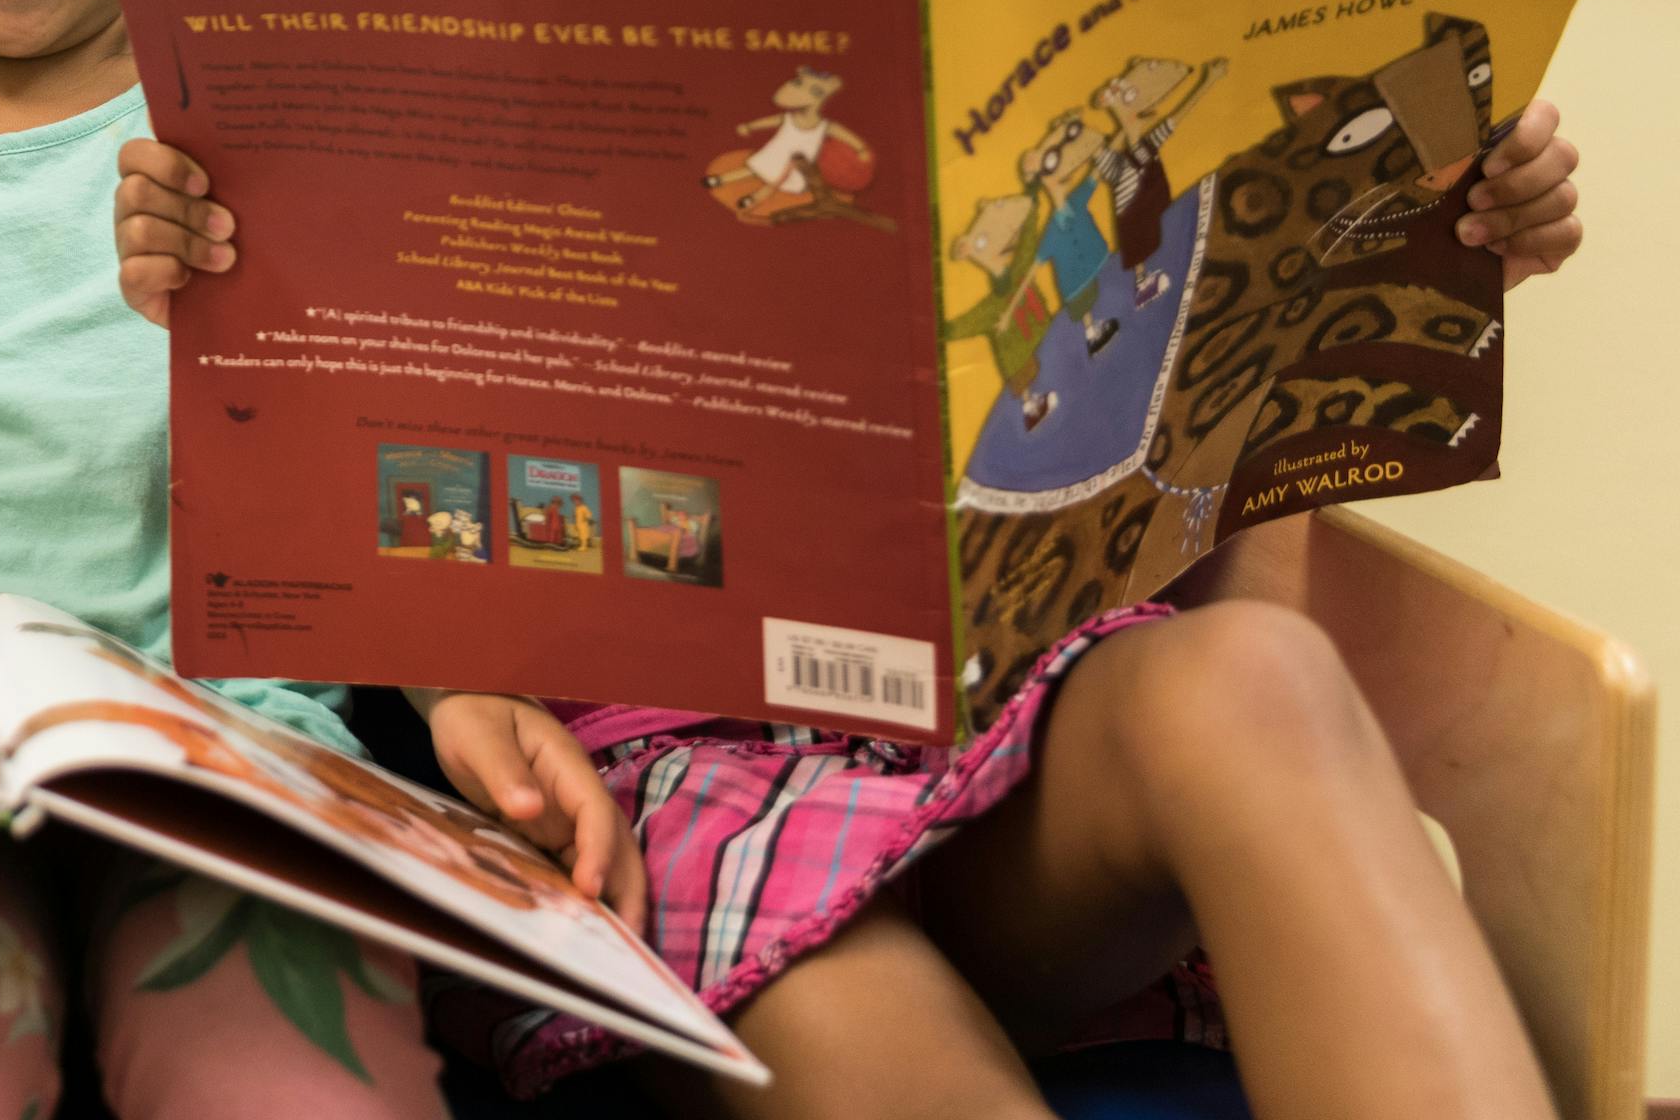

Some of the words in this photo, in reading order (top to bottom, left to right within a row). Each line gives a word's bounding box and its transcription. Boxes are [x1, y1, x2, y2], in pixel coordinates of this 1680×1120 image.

[184, 13, 252, 32] WILL
[260, 12, 348, 31] THEIR
[356, 12, 524, 42] FRIENDSHIP
[534, 22, 612, 46] EVER
[622, 25, 659, 47] BE
[670, 26, 732, 50] THE
[745, 28, 849, 54] SAME?
[1243, 6, 1326, 40] JAMES
[953, 23, 1072, 157] Horace
[344, 310, 387, 325] spirited
[390, 313, 430, 328] tribute
[432, 320, 446, 330] to
[447, 317, 508, 340] friendship
[510, 326, 533, 339] and
[308, 335, 339, 344] room
[341, 337, 357, 346] on
[359, 338, 386, 351] your
[389, 336, 429, 352] shelves
[431, 339, 449, 353] for
[451, 343, 496, 359] Dolores
[498, 349, 521, 362] and
[523, 350, 543, 364] her
[263, 358, 284, 367] can
[287, 354, 313, 372] only
[315, 355, 343, 373] hope
[345, 357, 367, 371] this
[368, 360, 378, 372] is
[379, 361, 402, 376] just
[404, 361, 422, 375] the
[424, 363, 485, 387] beginning
[486, 369, 504, 383] for
[598, 384, 621, 398] and
[1274, 443, 1347, 476] illustrated
[1351, 440, 1369, 458] by
[1241, 484, 1288, 516] AMY
[1296, 461, 1404, 497] WALROD
